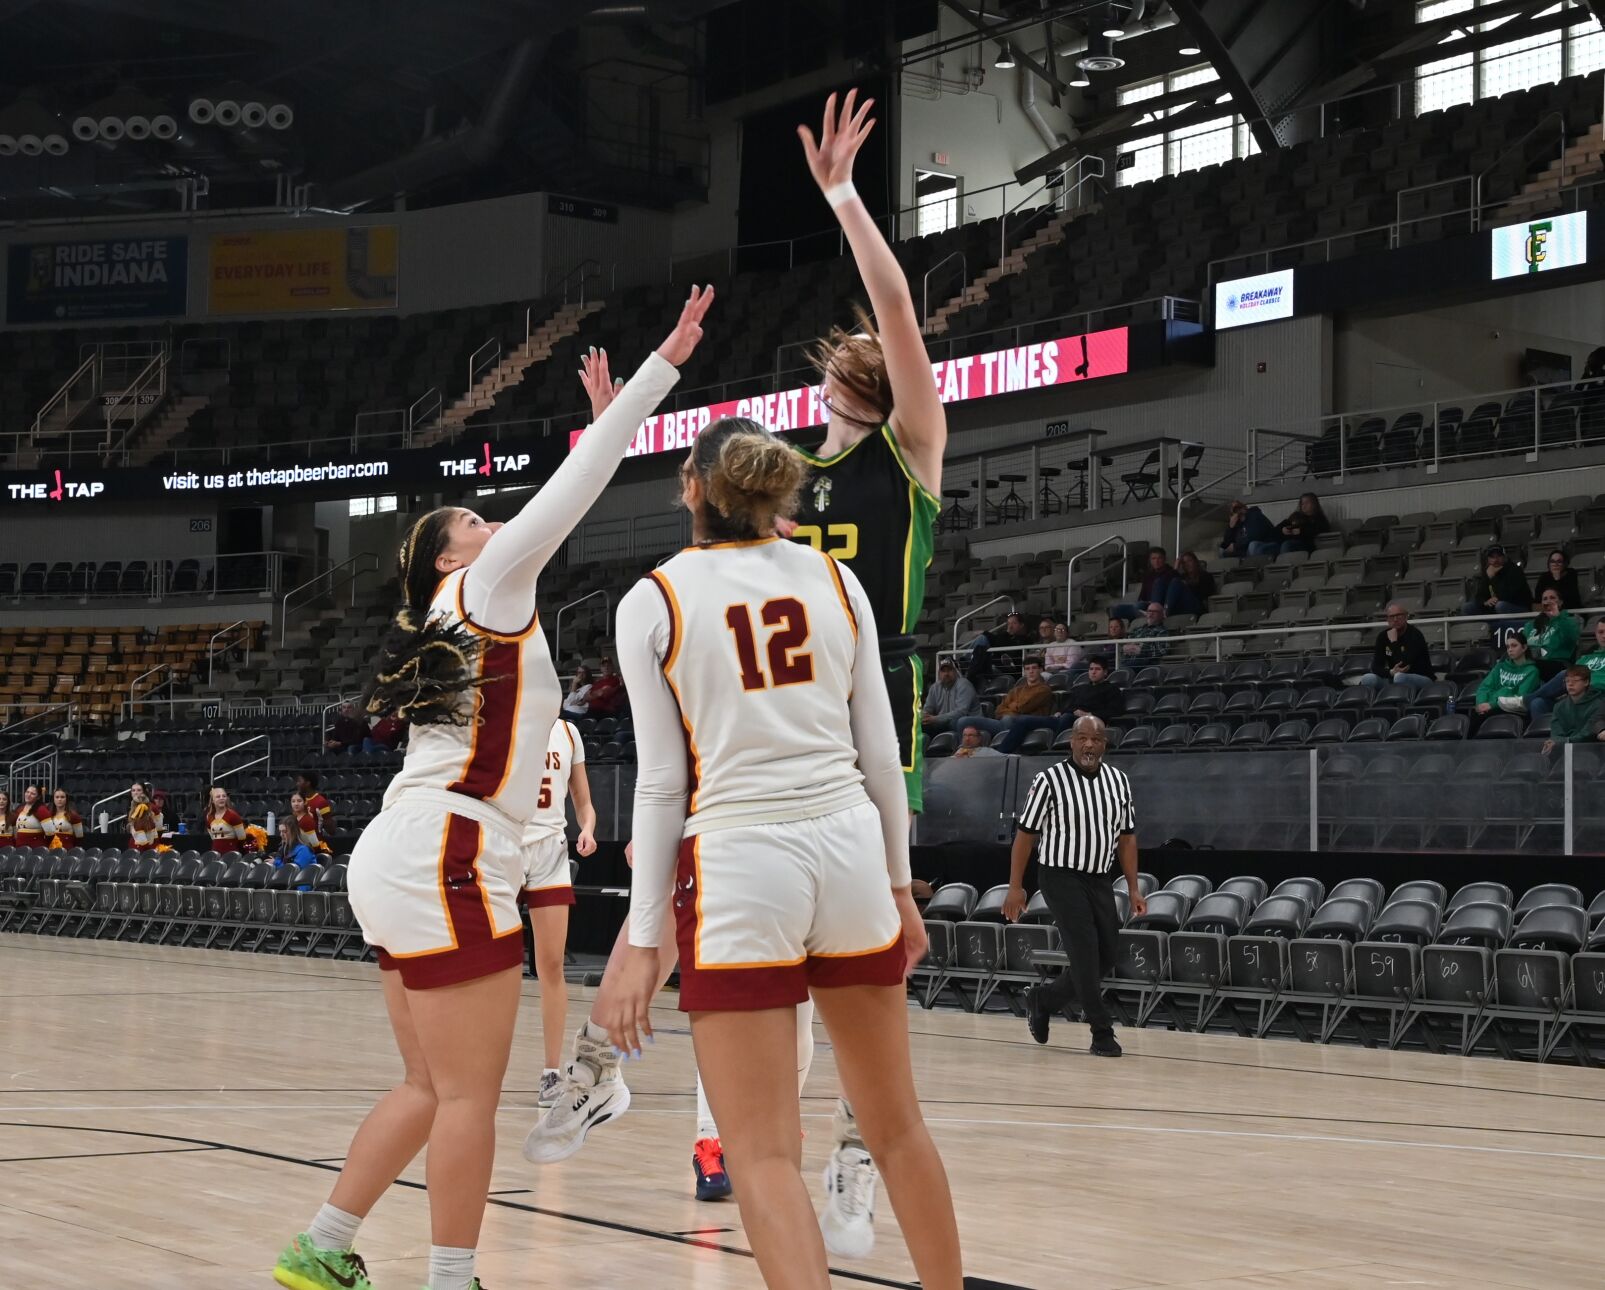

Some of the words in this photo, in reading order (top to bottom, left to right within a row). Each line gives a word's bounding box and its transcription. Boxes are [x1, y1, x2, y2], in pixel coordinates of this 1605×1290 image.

[56, 244, 106, 264] RIDE
[112, 240, 168, 261] SAFE
[55, 260, 168, 287] INDIANA
[215, 263, 294, 281] EVERYDAY
[299, 261, 331, 277] LIFE
[1241, 286, 1283, 303] BREAKAWAY
[981, 341, 1059, 397] TIMES
[163, 472, 200, 490] visit
[204, 474, 224, 489] us
[228, 471, 243, 488] at
[247, 461, 389, 488] thetapbeerbar.com
[439, 458, 477, 477] THE
[493, 454, 531, 473] TAP
[7, 483, 47, 499] THE
[64, 482, 105, 498] TAP
[191, 520, 210, 531] 206
[724, 595, 816, 693] 12
[203, 705, 218, 719] 107
[1243, 944, 1260, 969] 57
[1370, 952, 1395, 977] 59
[1440, 957, 1459, 978] 60
